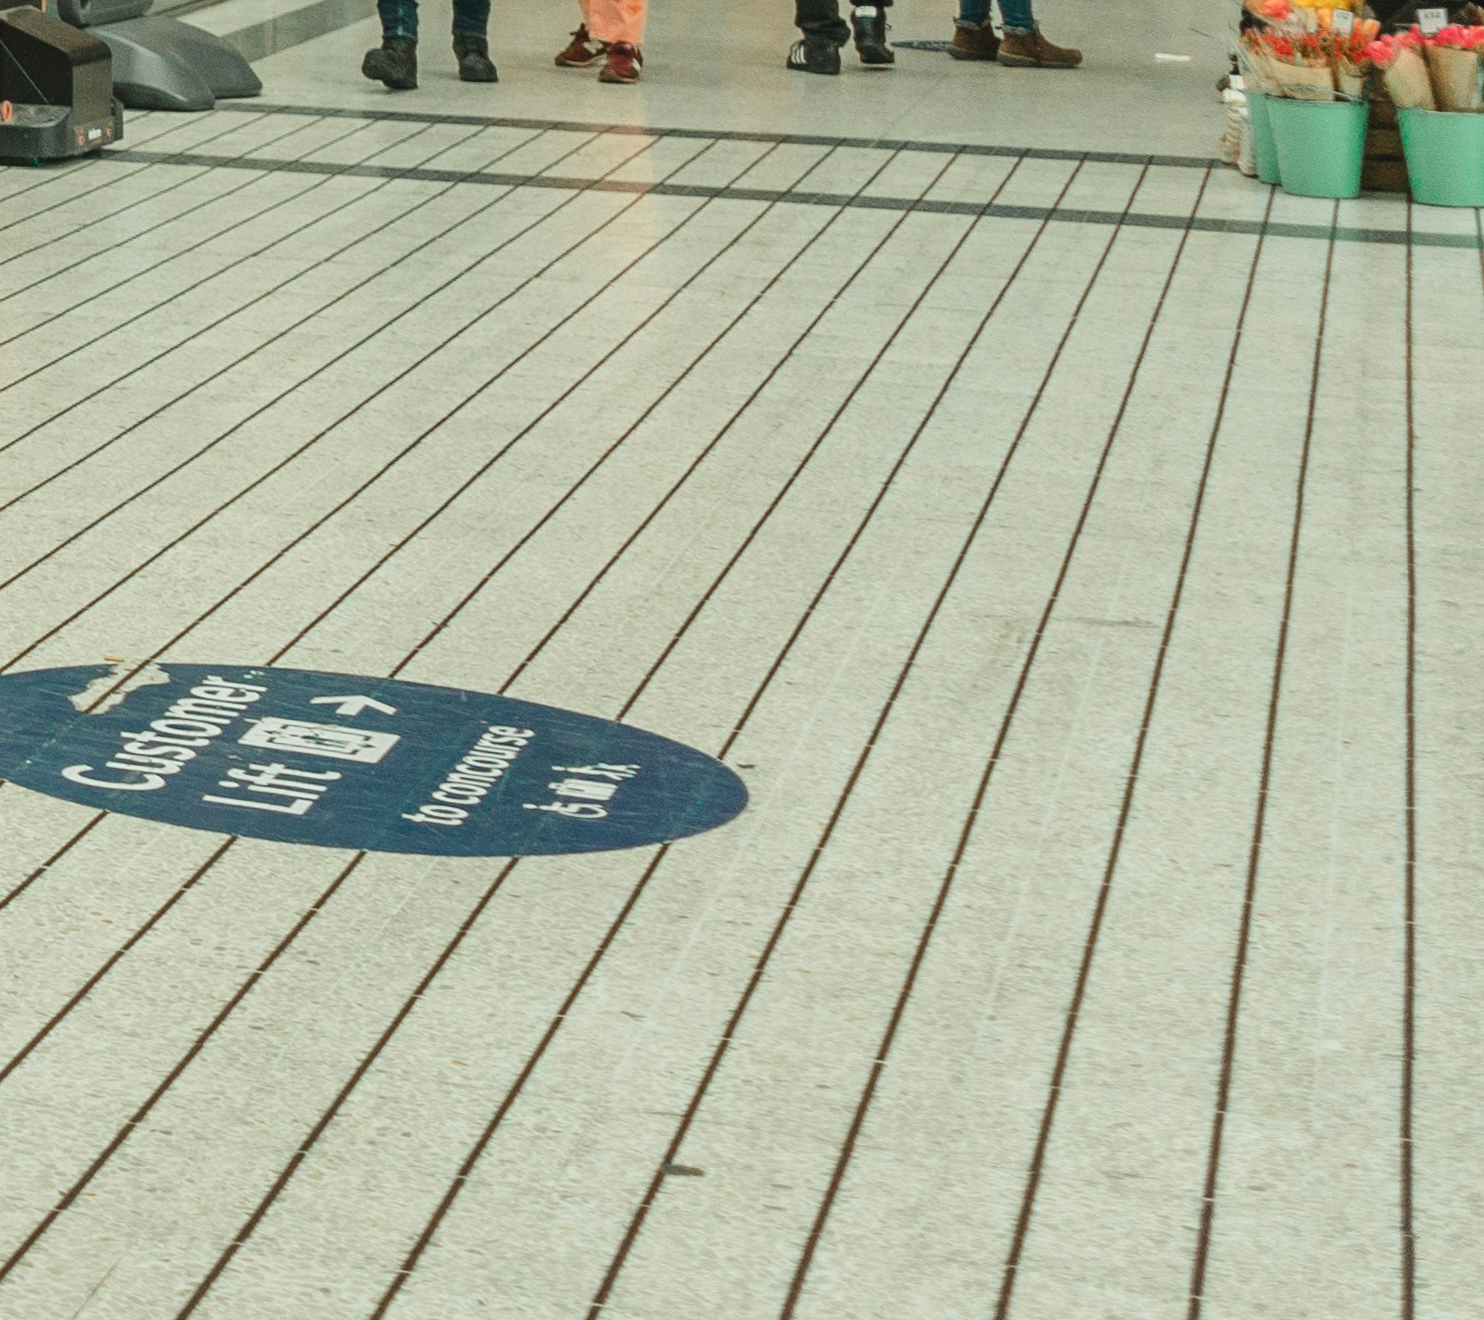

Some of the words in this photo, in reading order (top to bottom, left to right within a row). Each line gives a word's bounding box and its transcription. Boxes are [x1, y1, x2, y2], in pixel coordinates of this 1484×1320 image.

[61, 675, 268, 791] Customer
[430, 724, 535, 807] concourse
[202, 762, 342, 816] Lift
[401, 804, 469, 826] to
